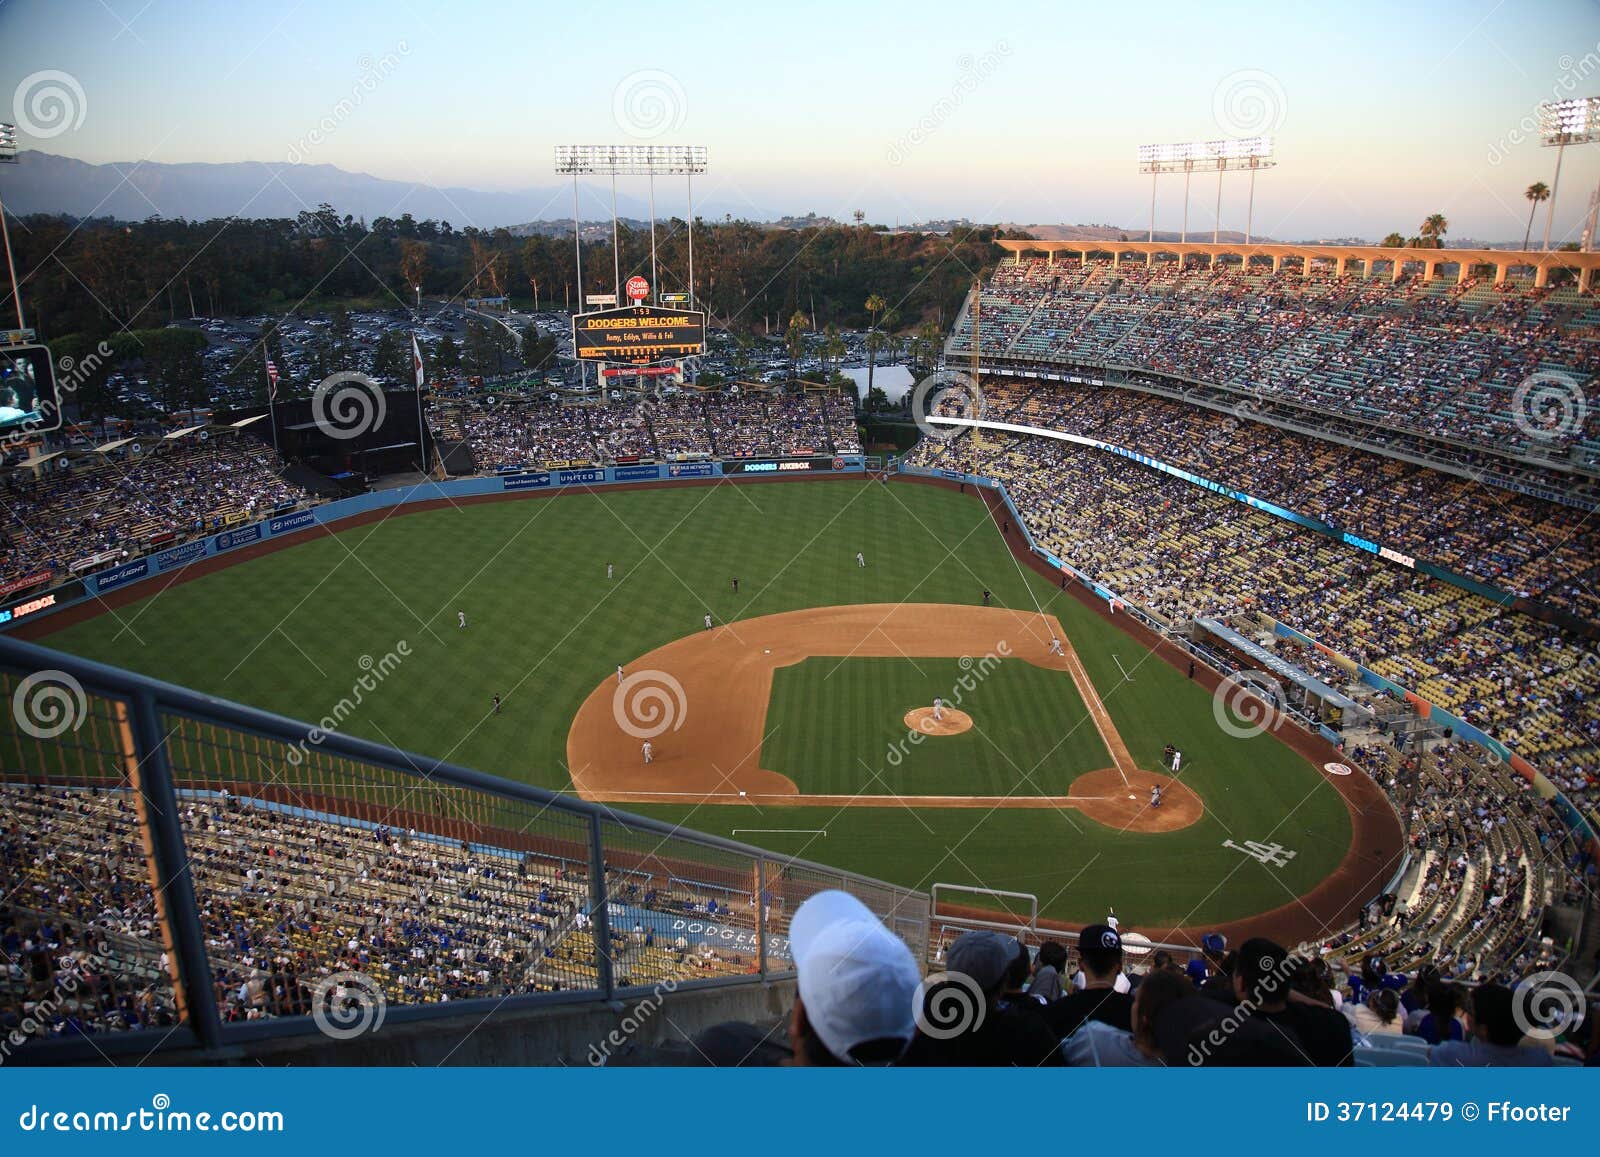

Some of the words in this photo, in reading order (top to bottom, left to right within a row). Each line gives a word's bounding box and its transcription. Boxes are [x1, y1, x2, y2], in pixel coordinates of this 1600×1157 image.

[587, 318, 637, 328] DODGERS
[638, 316, 689, 327] WELCOME
[744, 462, 778, 472] DODGERS
[778, 462, 810, 471] JUKEBOX
[560, 473, 594, 482] UNITED
[99, 574, 119, 586] BUD
